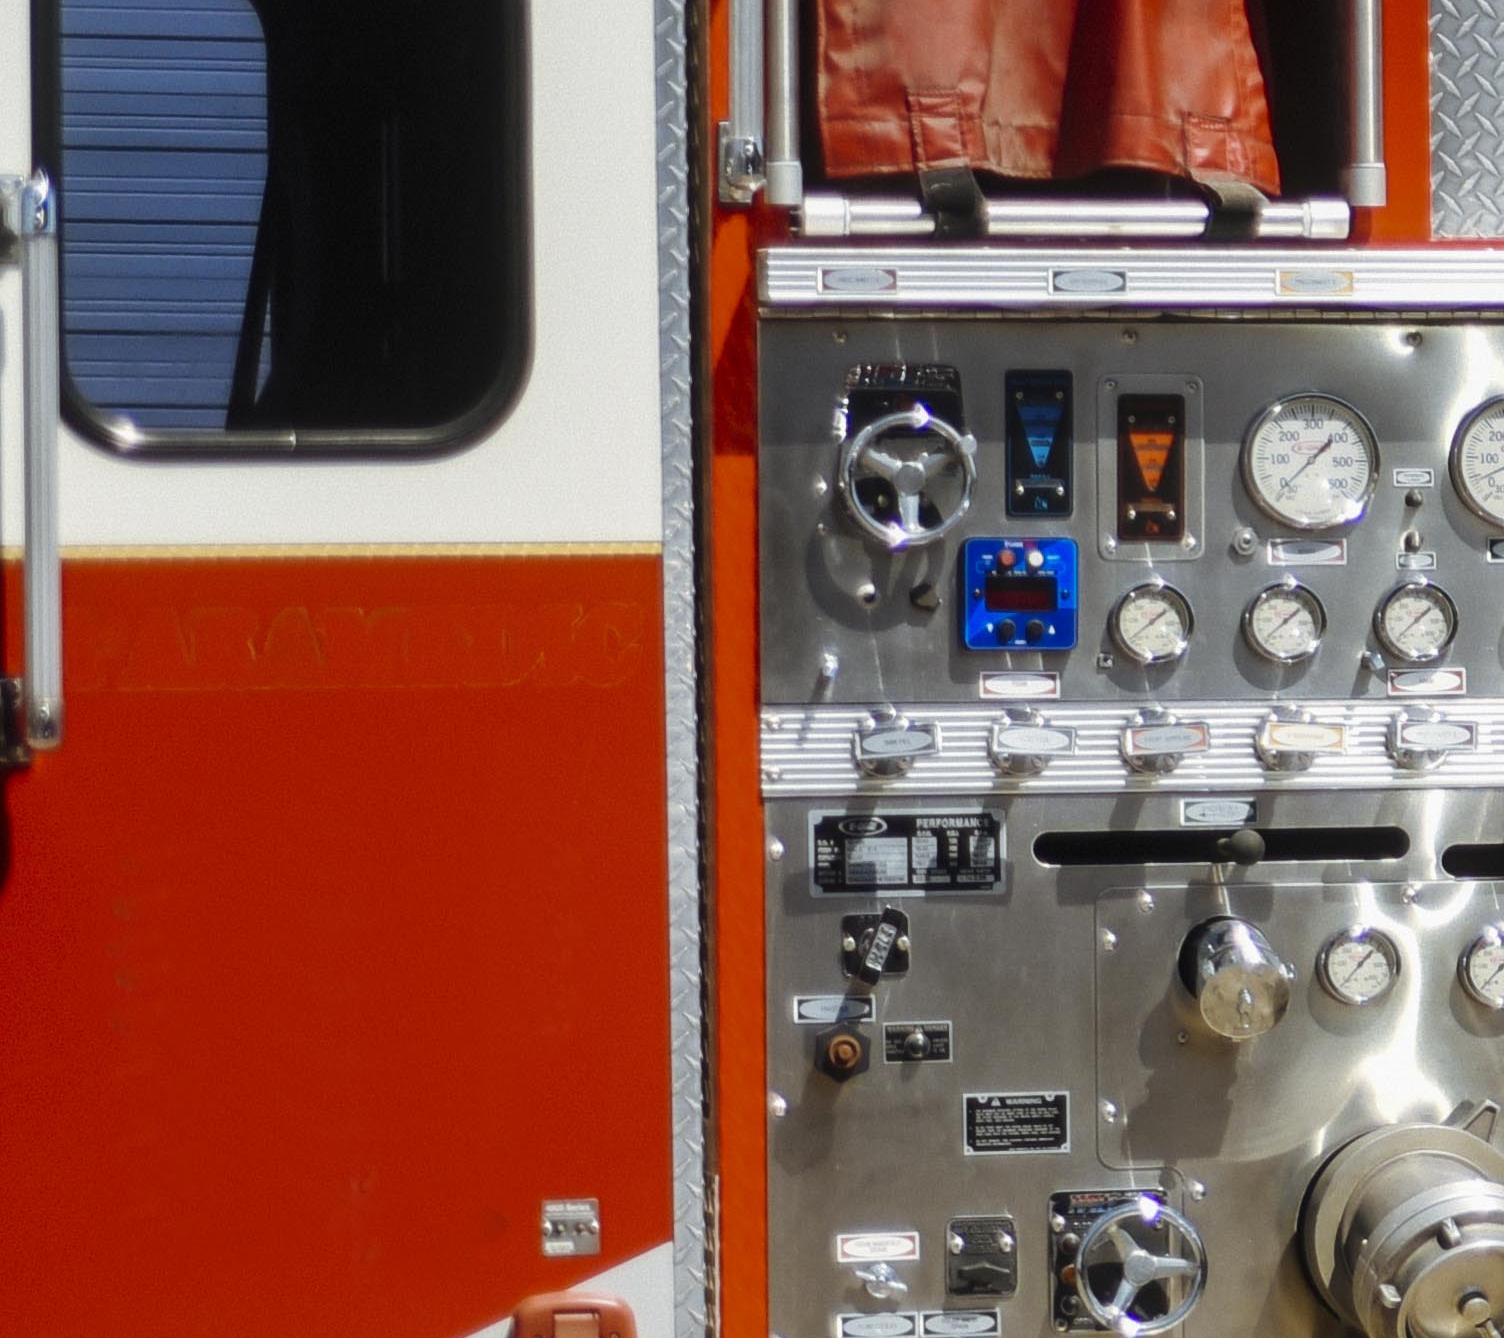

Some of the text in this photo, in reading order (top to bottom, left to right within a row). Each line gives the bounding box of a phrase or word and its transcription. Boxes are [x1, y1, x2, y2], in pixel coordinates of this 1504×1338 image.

[1303, 420, 1324, 430] 300
[1279, 431, 1300, 441] 200
[1271, 454, 1290, 464] 100
[1332, 457, 1353, 467] 500
[1480, 453, 1499, 464] 100
[1488, 477, 1495, 487] 0
[916, 818, 990, 829] PERFORMANCE
